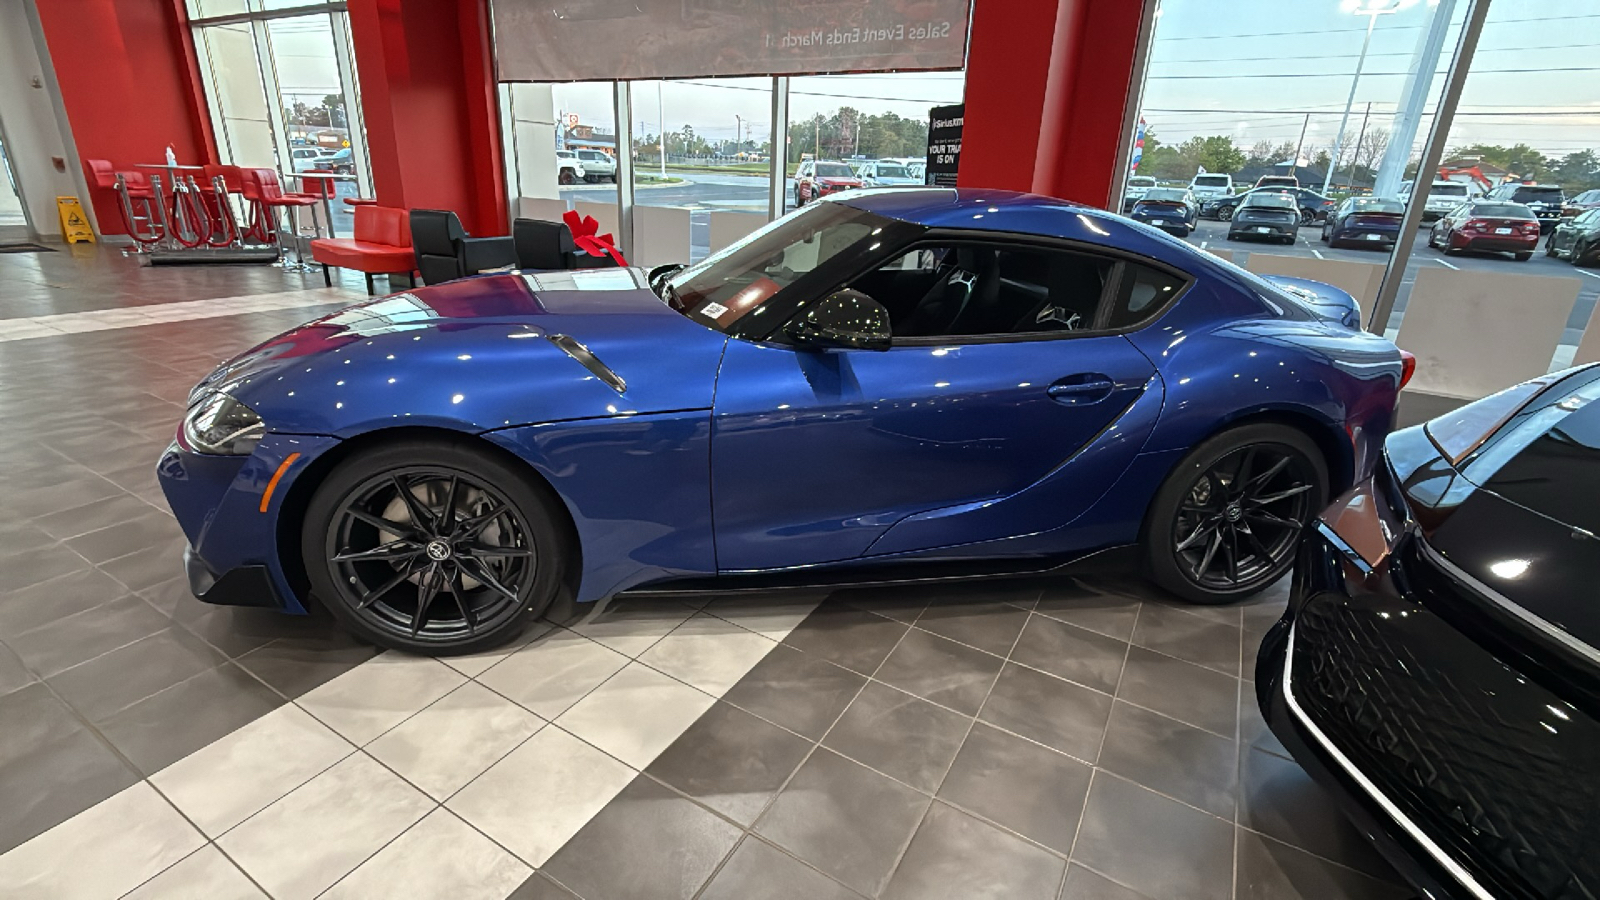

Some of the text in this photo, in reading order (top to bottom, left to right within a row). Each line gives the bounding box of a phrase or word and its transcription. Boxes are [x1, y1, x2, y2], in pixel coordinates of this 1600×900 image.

[929, 144, 946, 155] YOUR
[937, 154, 955, 164] IS ON
